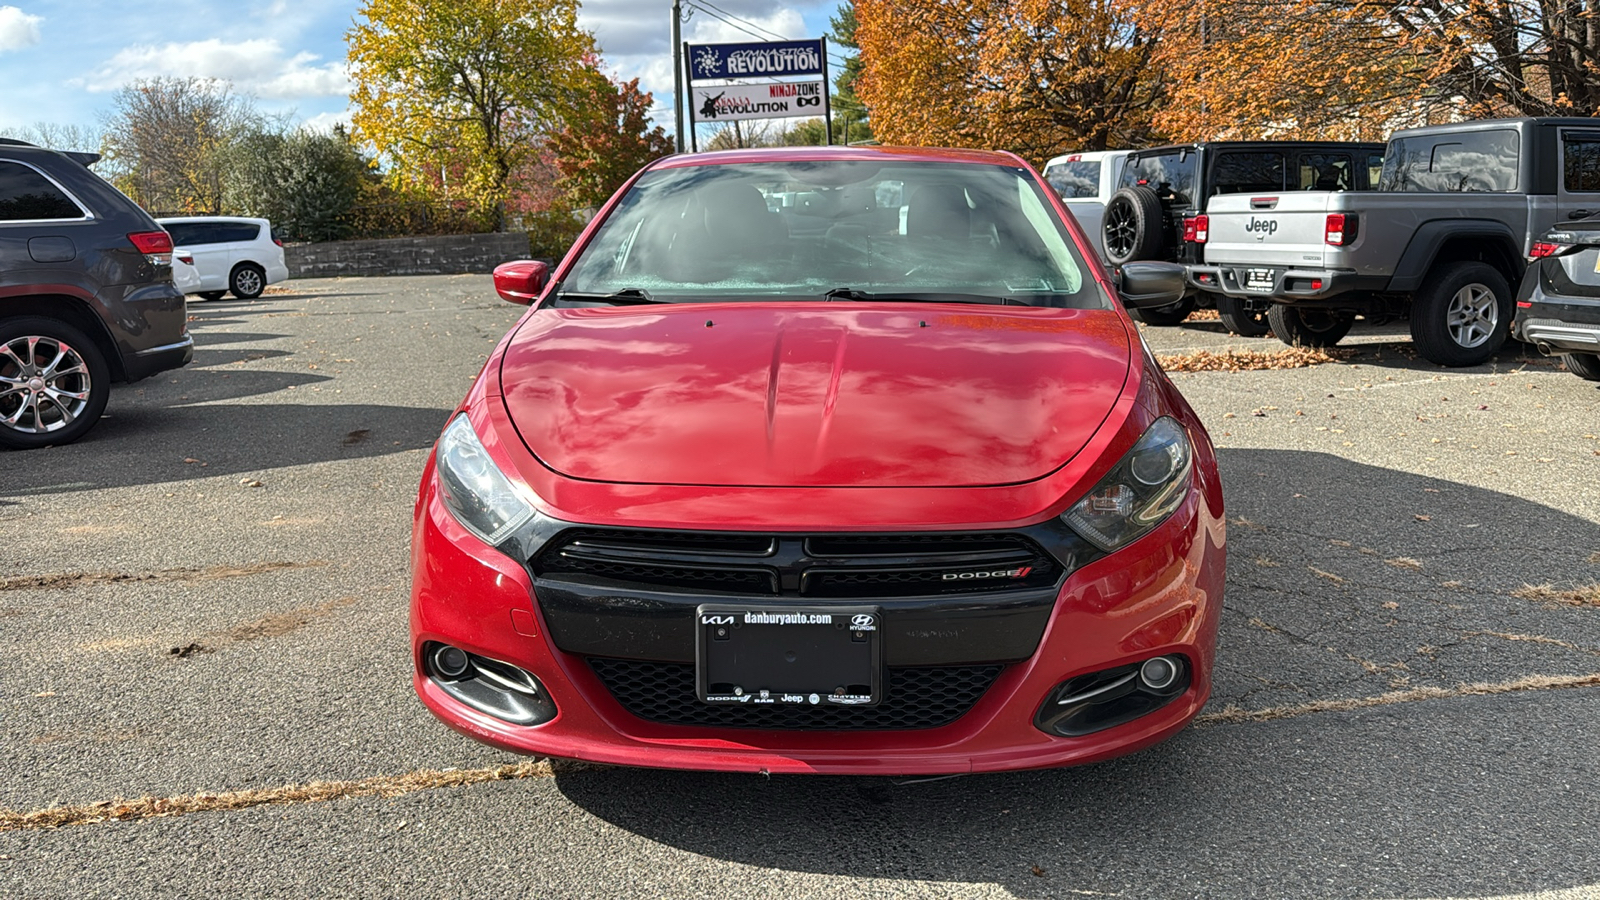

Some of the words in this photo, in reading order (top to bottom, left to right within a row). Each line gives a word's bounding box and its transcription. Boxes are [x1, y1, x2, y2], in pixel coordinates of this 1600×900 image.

[730, 47, 814, 58] GYMNASTICS
[727, 53, 819, 73] REVOLUTION
[769, 83, 820, 97] NINJAZONE
[714, 102, 788, 115] REVOLUTION
[1245, 216, 1278, 235] Jeep
[942, 569, 1021, 580] DODGE
[744, 611, 832, 625] danburyauto.com
[781, 693, 804, 704] Jeep
